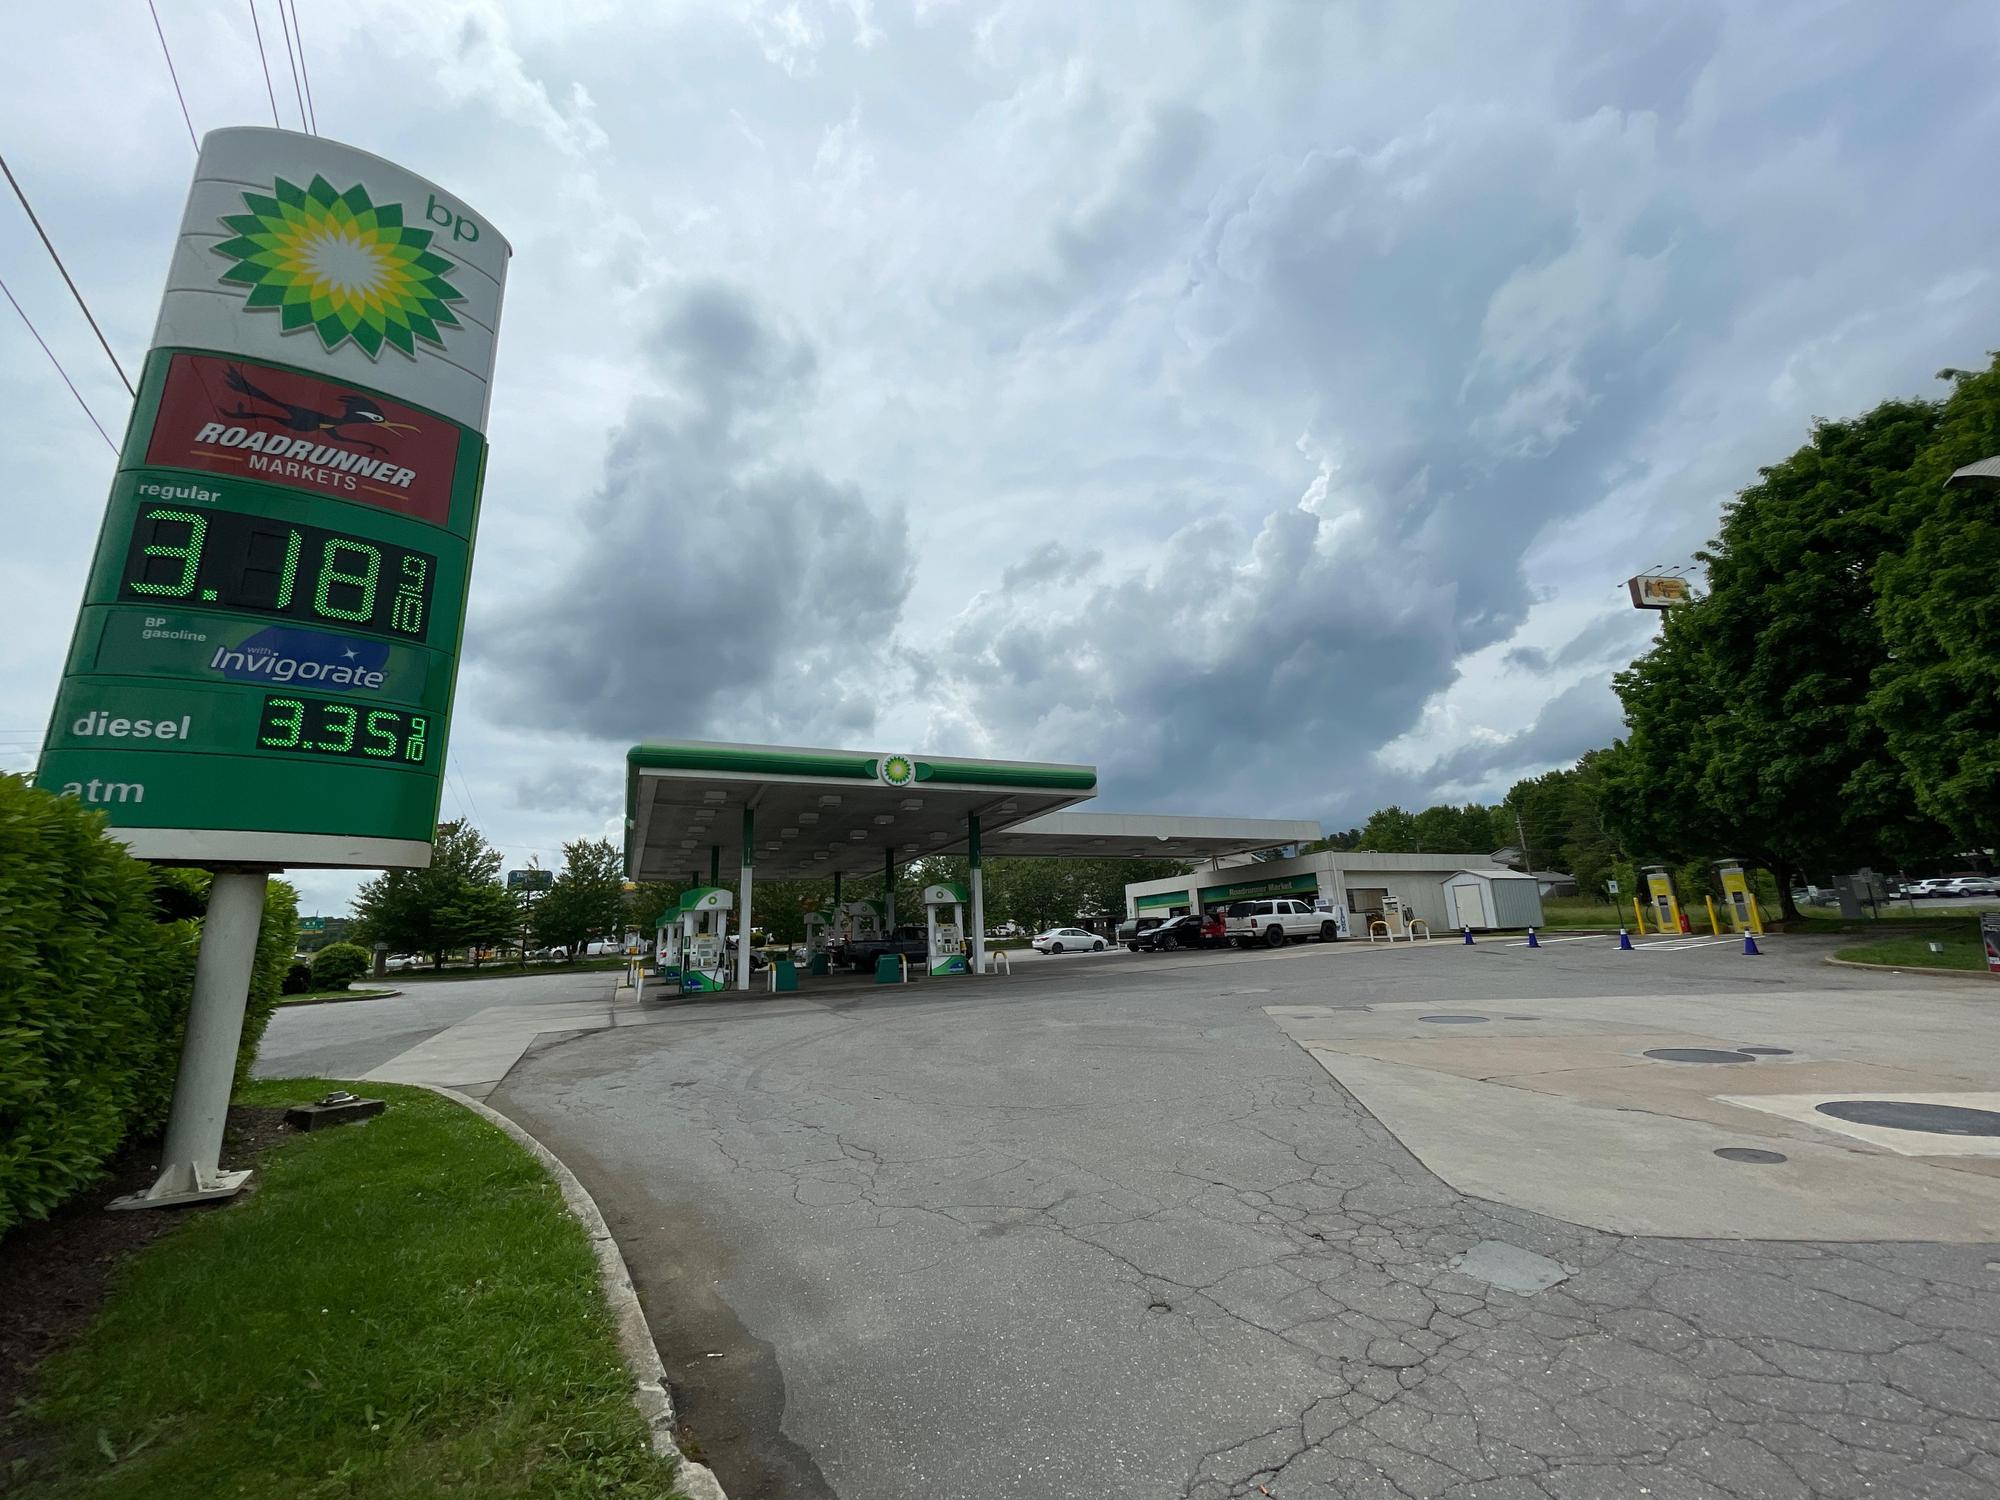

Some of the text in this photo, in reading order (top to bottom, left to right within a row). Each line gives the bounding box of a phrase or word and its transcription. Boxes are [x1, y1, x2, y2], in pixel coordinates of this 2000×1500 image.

[426, 194, 479, 242] bp
[194, 421, 417, 489] ROADRUNNER
[248, 454, 358, 491] MARKETS
[138, 483, 222, 504] regular
[130, 509, 382, 623] 3.18
[142, 629, 207, 642] gasoline
[145, 616, 167, 628] BP
[210, 646, 385, 689] Invigorate
[247, 646, 272, 656] with
[72, 698, 400, 758] diesel 3.35
[60, 778, 144, 803] atm
